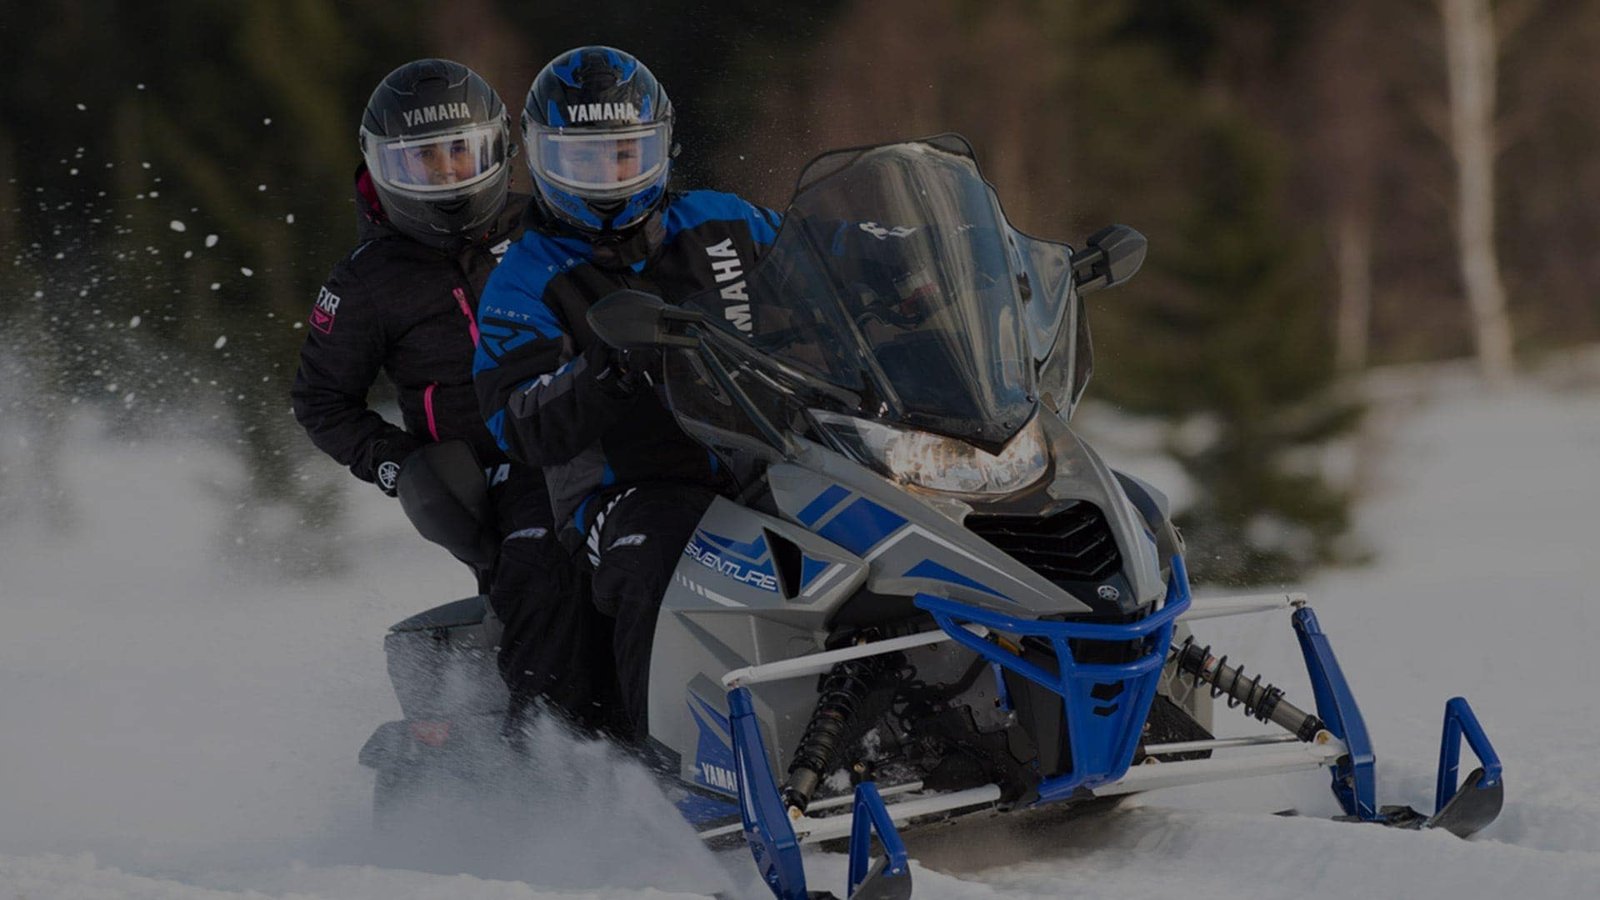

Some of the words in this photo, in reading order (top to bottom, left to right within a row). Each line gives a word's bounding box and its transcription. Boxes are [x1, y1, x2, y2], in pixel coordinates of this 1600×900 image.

[402, 102, 471, 128] YAMAHA
[567, 102, 637, 123] YAMAHA
[316, 285, 341, 315] FXR
[705, 237, 754, 338] MAHA
